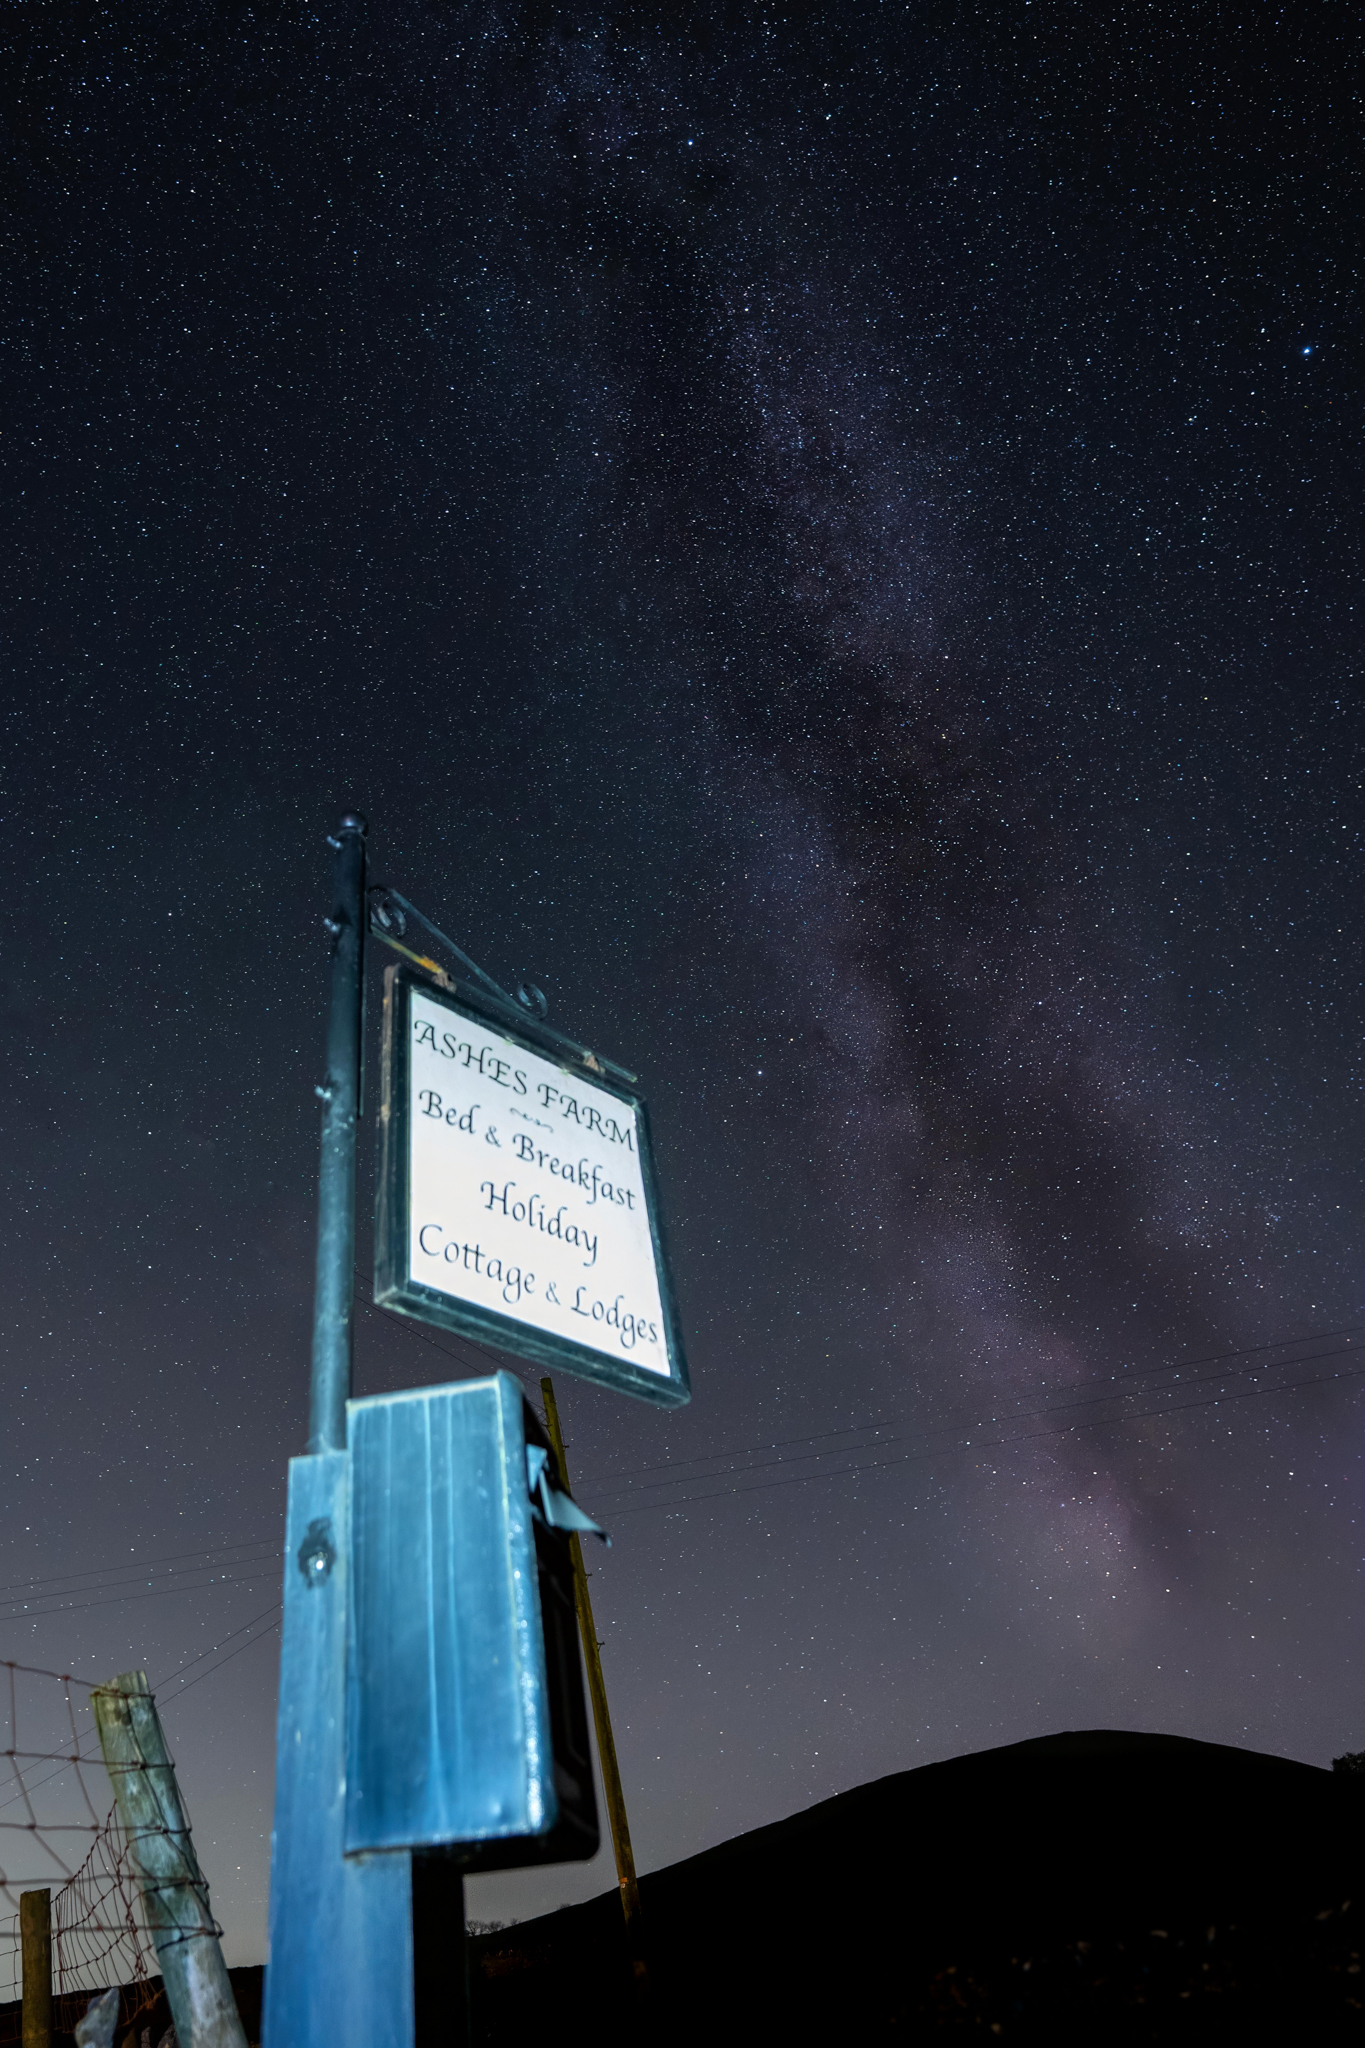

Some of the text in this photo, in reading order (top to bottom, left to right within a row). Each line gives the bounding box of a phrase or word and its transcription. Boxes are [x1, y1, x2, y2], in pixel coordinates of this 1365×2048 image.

[414, 1019, 636, 1152] ASHES FARM
[418, 1089, 636, 1210] Bed & Breakfast
[419, 1223, 658, 1348] Cottage & Lodges
[480, 1181, 598, 1267] Holiday
